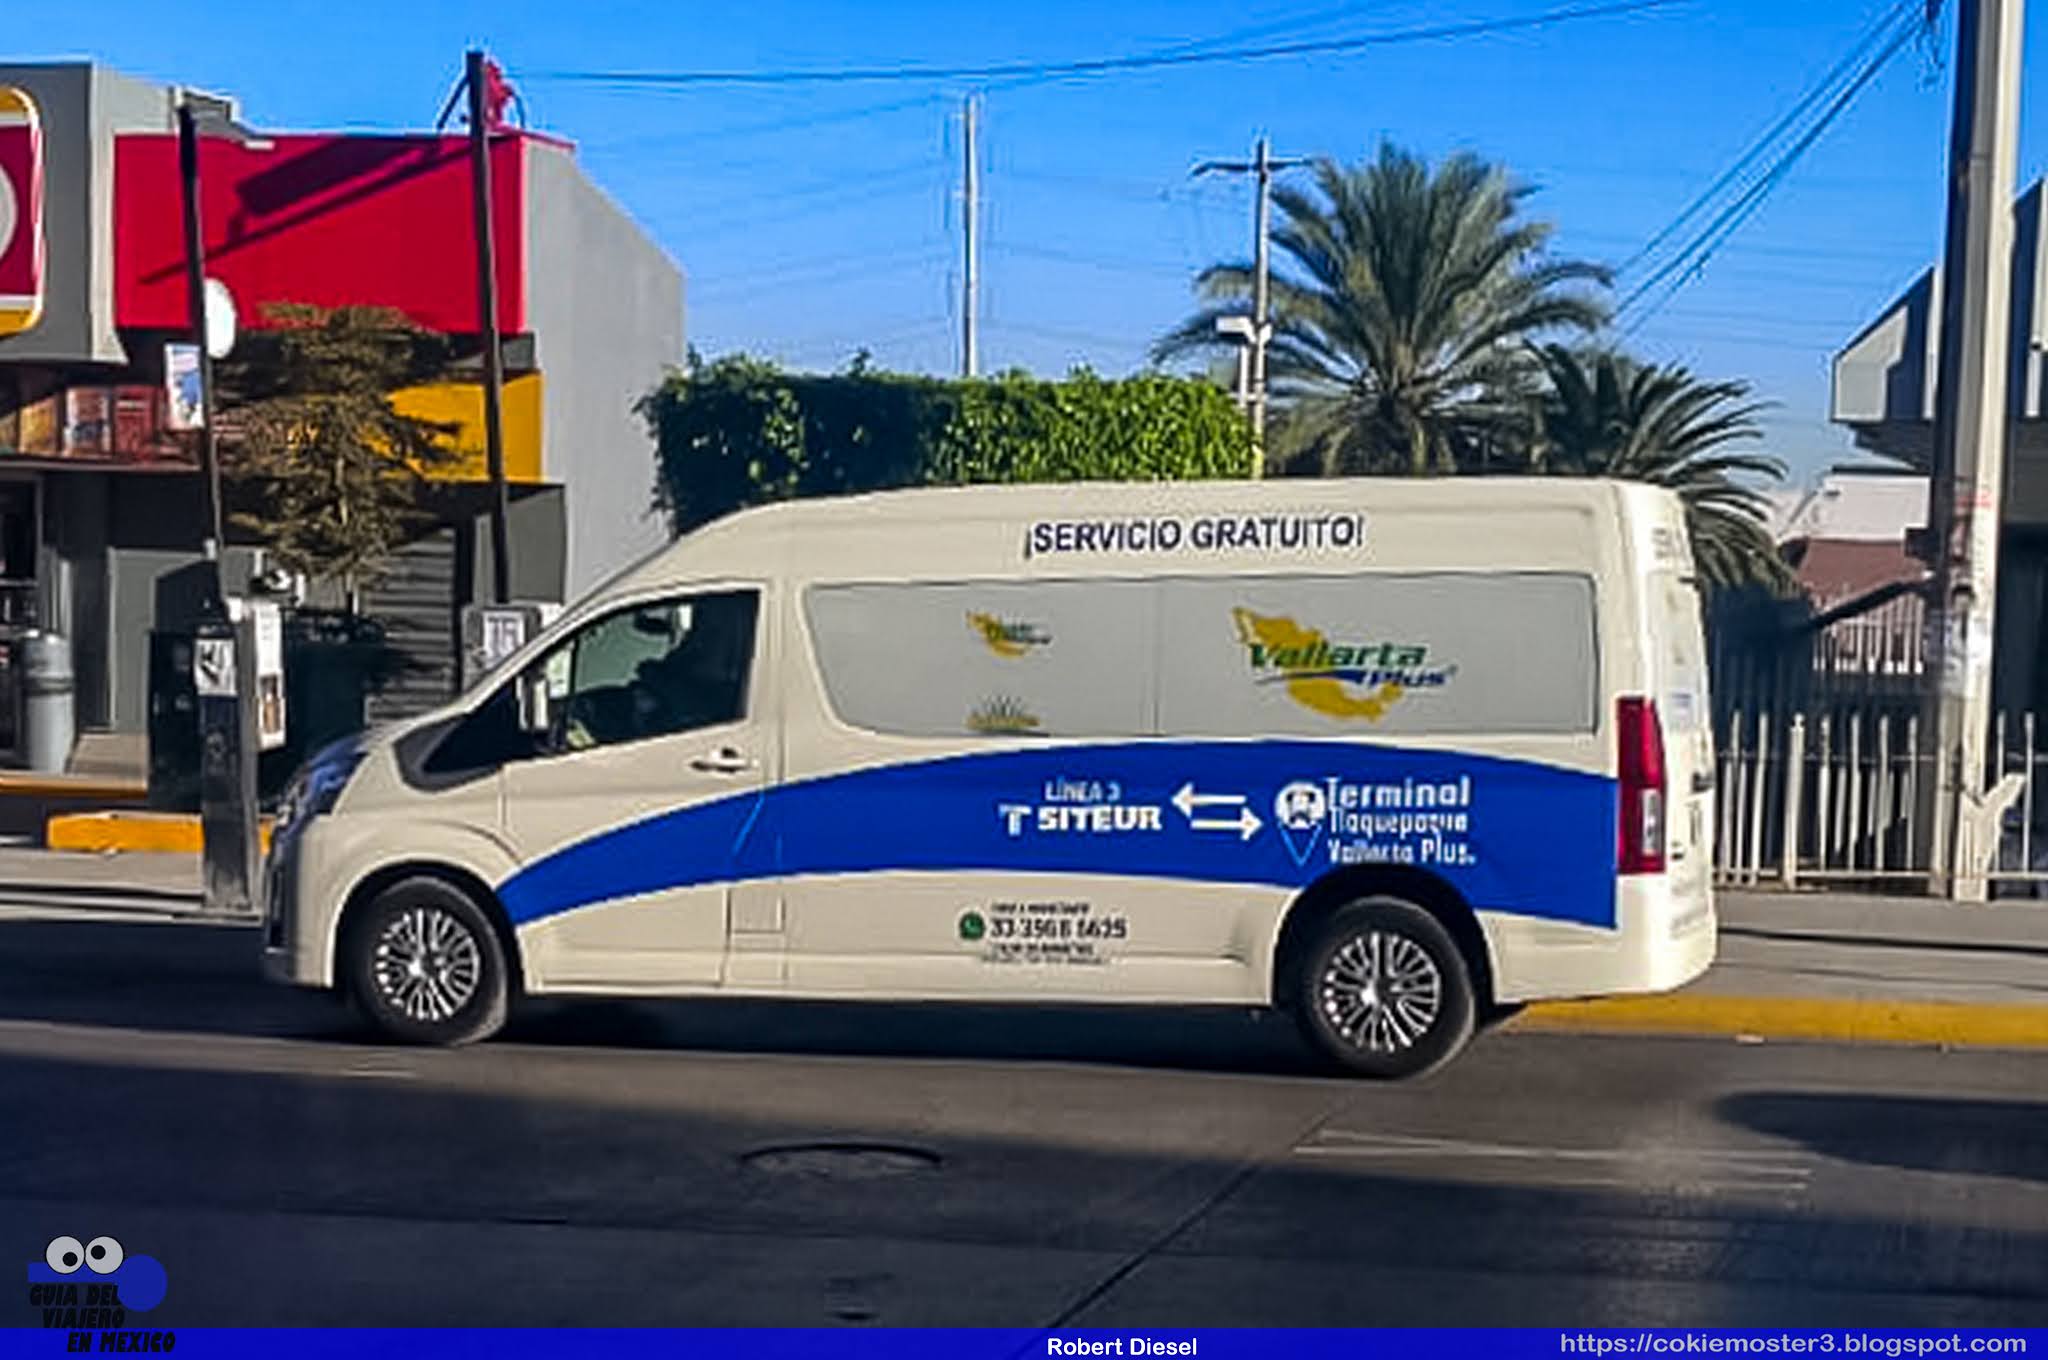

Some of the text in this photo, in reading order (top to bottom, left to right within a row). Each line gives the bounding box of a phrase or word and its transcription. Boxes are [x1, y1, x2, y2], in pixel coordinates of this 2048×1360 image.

[1024, 515, 1364, 559] ¡SERVICIO GRATUITO!
[1250, 641, 1427, 669] Vallarta
[1323, 775, 1470, 807] Terminal
[1037, 804, 1163, 832] SITEUR
